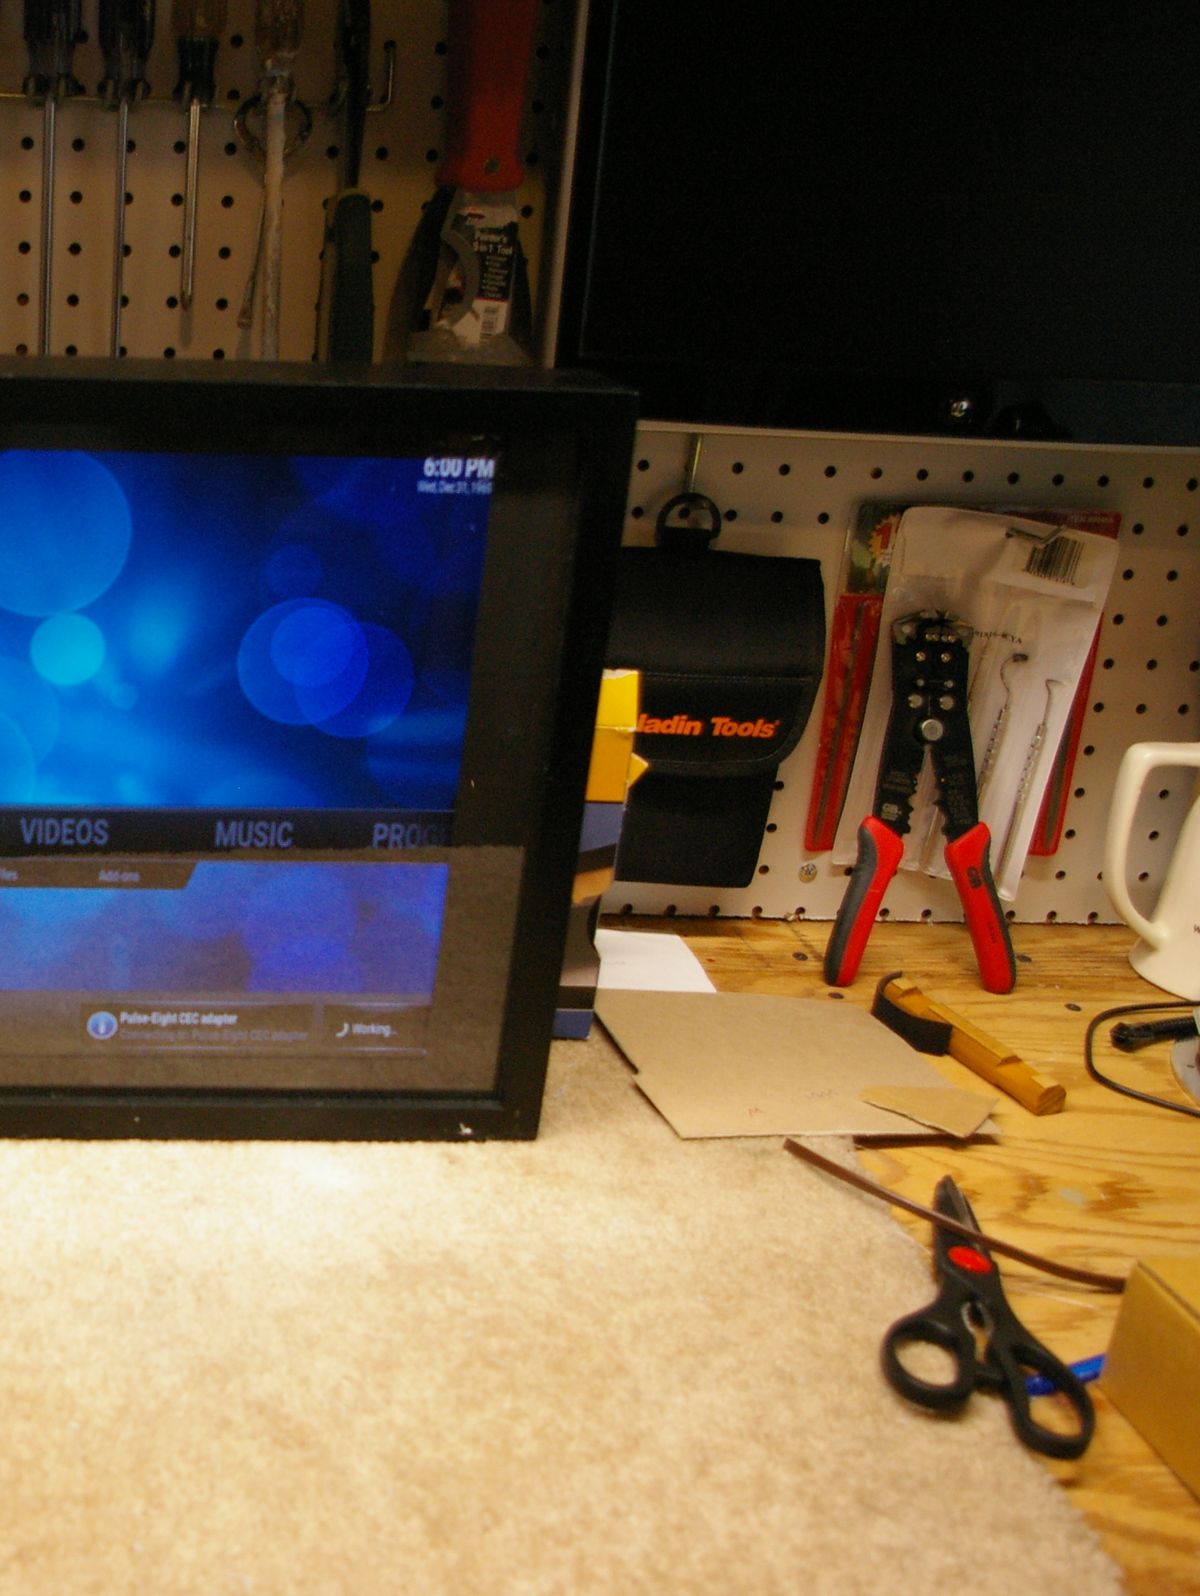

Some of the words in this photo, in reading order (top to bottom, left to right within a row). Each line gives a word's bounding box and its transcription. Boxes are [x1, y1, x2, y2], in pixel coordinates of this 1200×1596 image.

[423, 457, 462, 478] 6:00
[464, 458, 495, 478] PM
[638, 713, 703, 737] ladin
[709, 716, 777, 739] Tools
[19, 816, 109, 845] VIDEOS
[214, 820, 294, 848] MUSIC
[119, 1011, 178, 1027] Pulse-Eight
[179, 1012, 200, 1025] CEC
